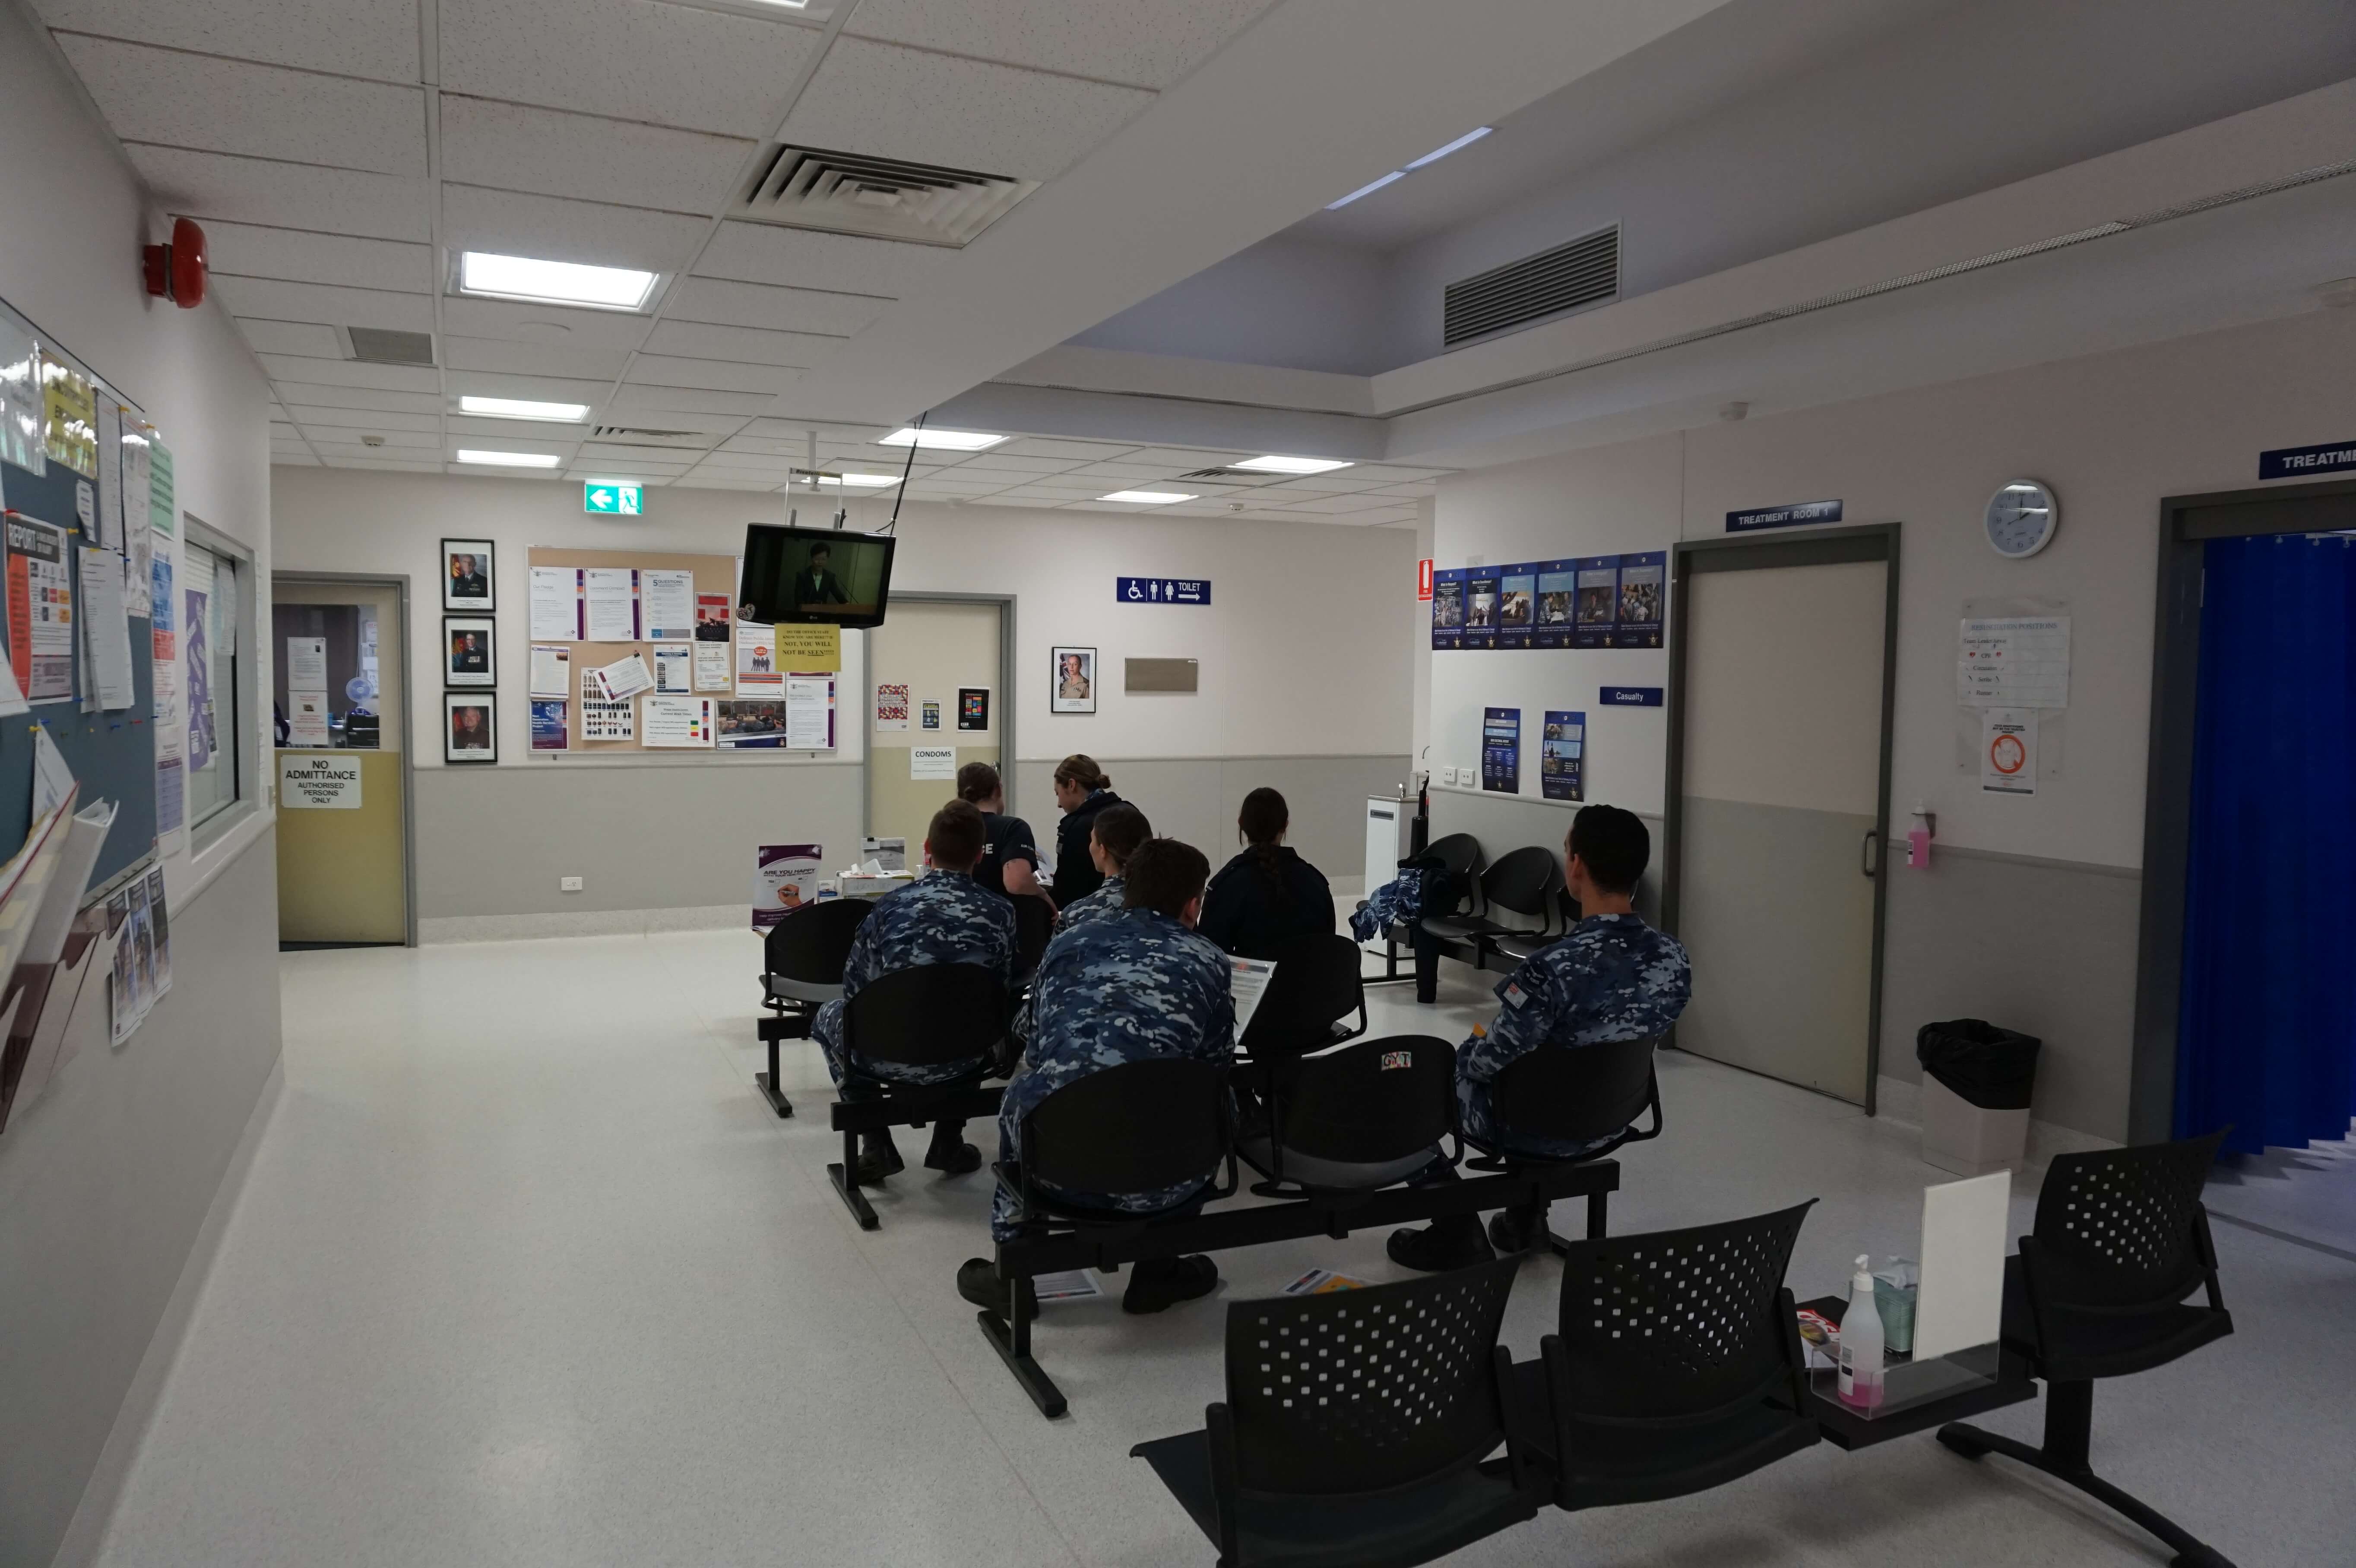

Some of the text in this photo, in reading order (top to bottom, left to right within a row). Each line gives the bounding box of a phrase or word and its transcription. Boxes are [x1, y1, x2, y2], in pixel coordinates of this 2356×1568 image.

[1738, 508, 1828, 525] TREATMENT ROOM 1
[8, 523, 36, 551] REPORT
[1178, 582, 1200, 591] TOILET
[1616, 691, 1644, 702] Casualty
[312, 761, 328, 769] NO
[286, 770, 356, 779] ADMITTANCE
